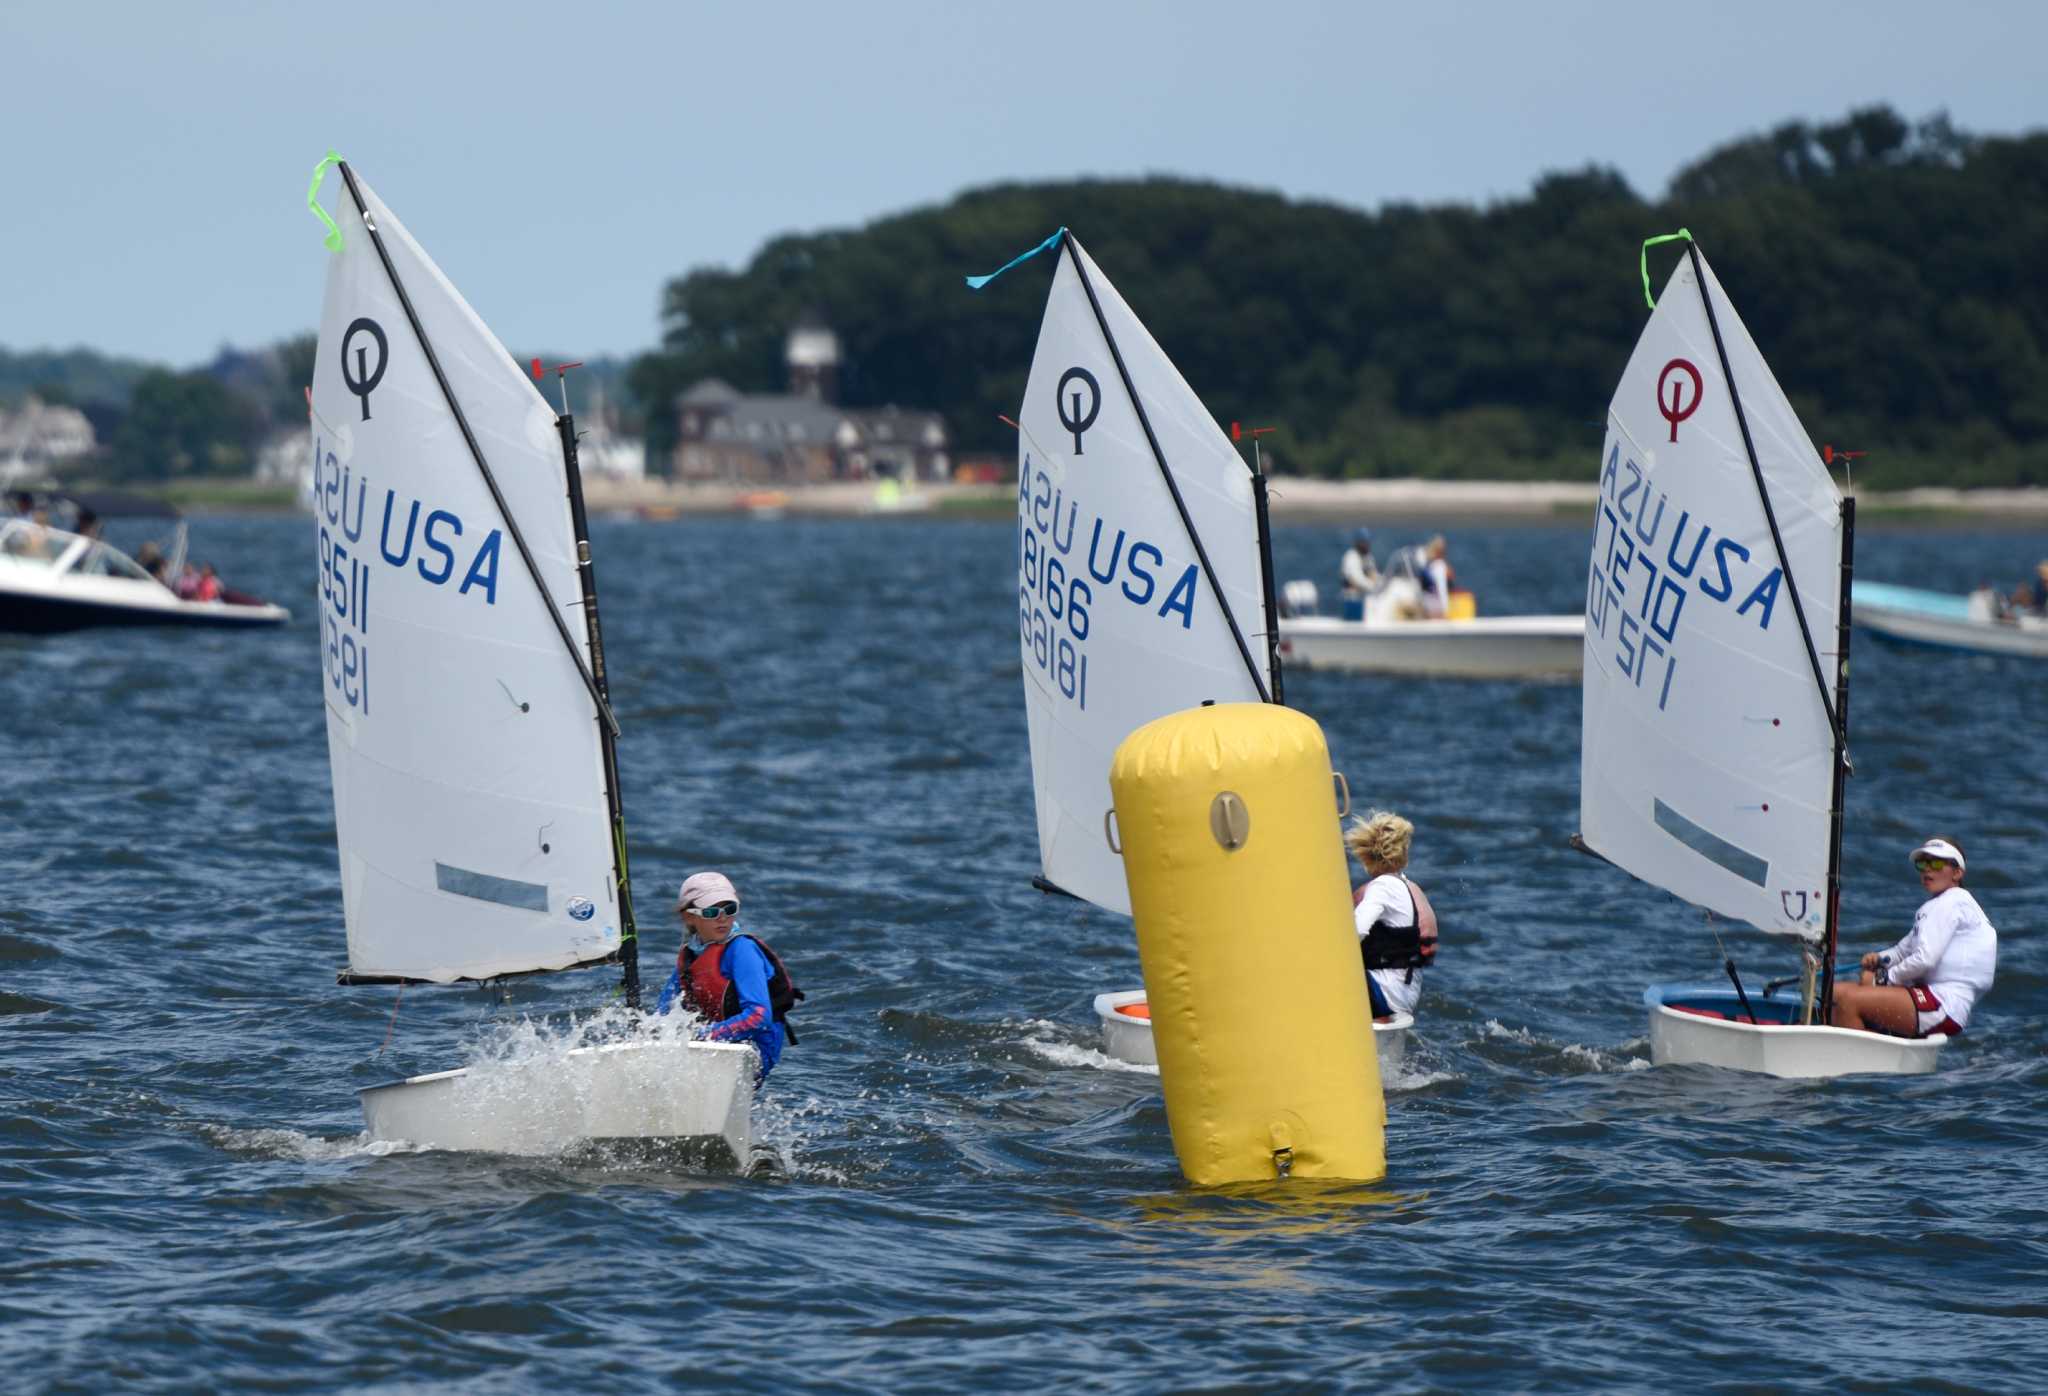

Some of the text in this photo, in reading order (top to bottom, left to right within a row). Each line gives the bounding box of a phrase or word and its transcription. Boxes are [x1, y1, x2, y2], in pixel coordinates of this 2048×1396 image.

[380, 489, 504, 605] USA
[1087, 517, 1200, 630] USA
[1592, 494, 1687, 644] 17270
[1667, 510, 1784, 631] USA
